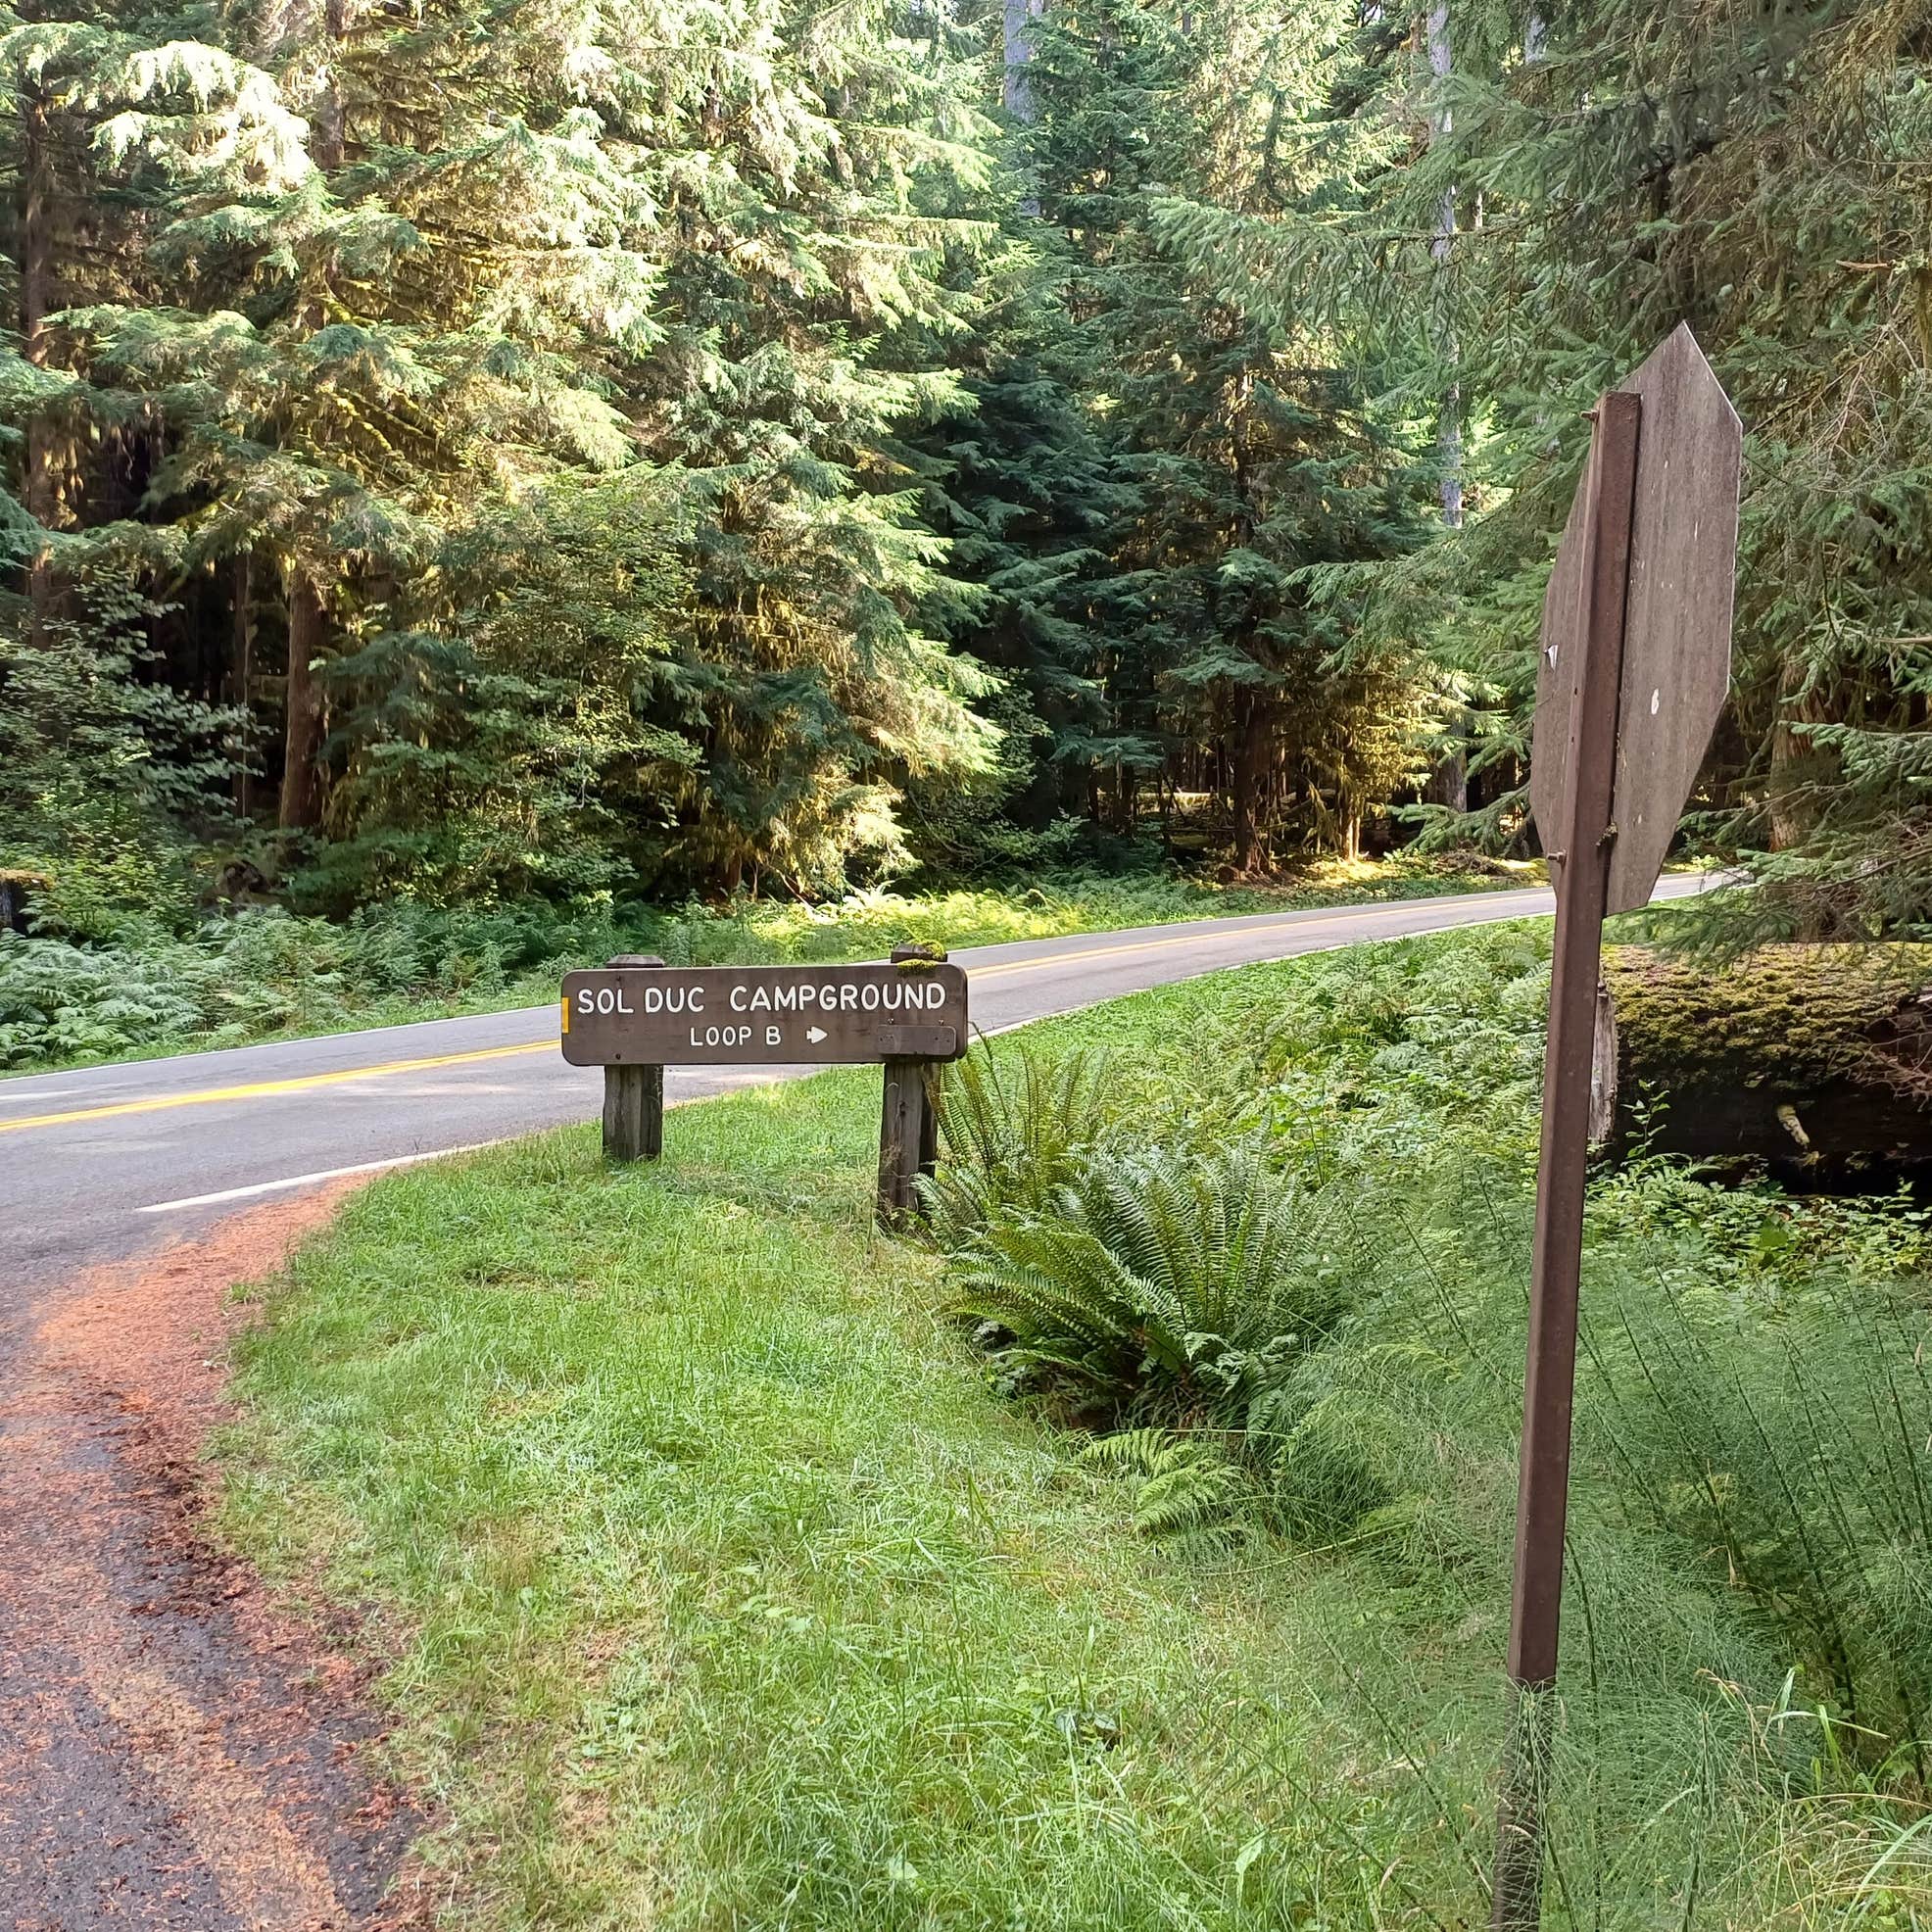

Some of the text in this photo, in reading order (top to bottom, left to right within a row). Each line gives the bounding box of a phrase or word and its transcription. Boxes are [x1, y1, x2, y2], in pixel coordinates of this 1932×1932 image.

[577, 982, 946, 1014] SOL DUC CAMPGROUND
[690, 1025, 782, 1047] LOOP B
